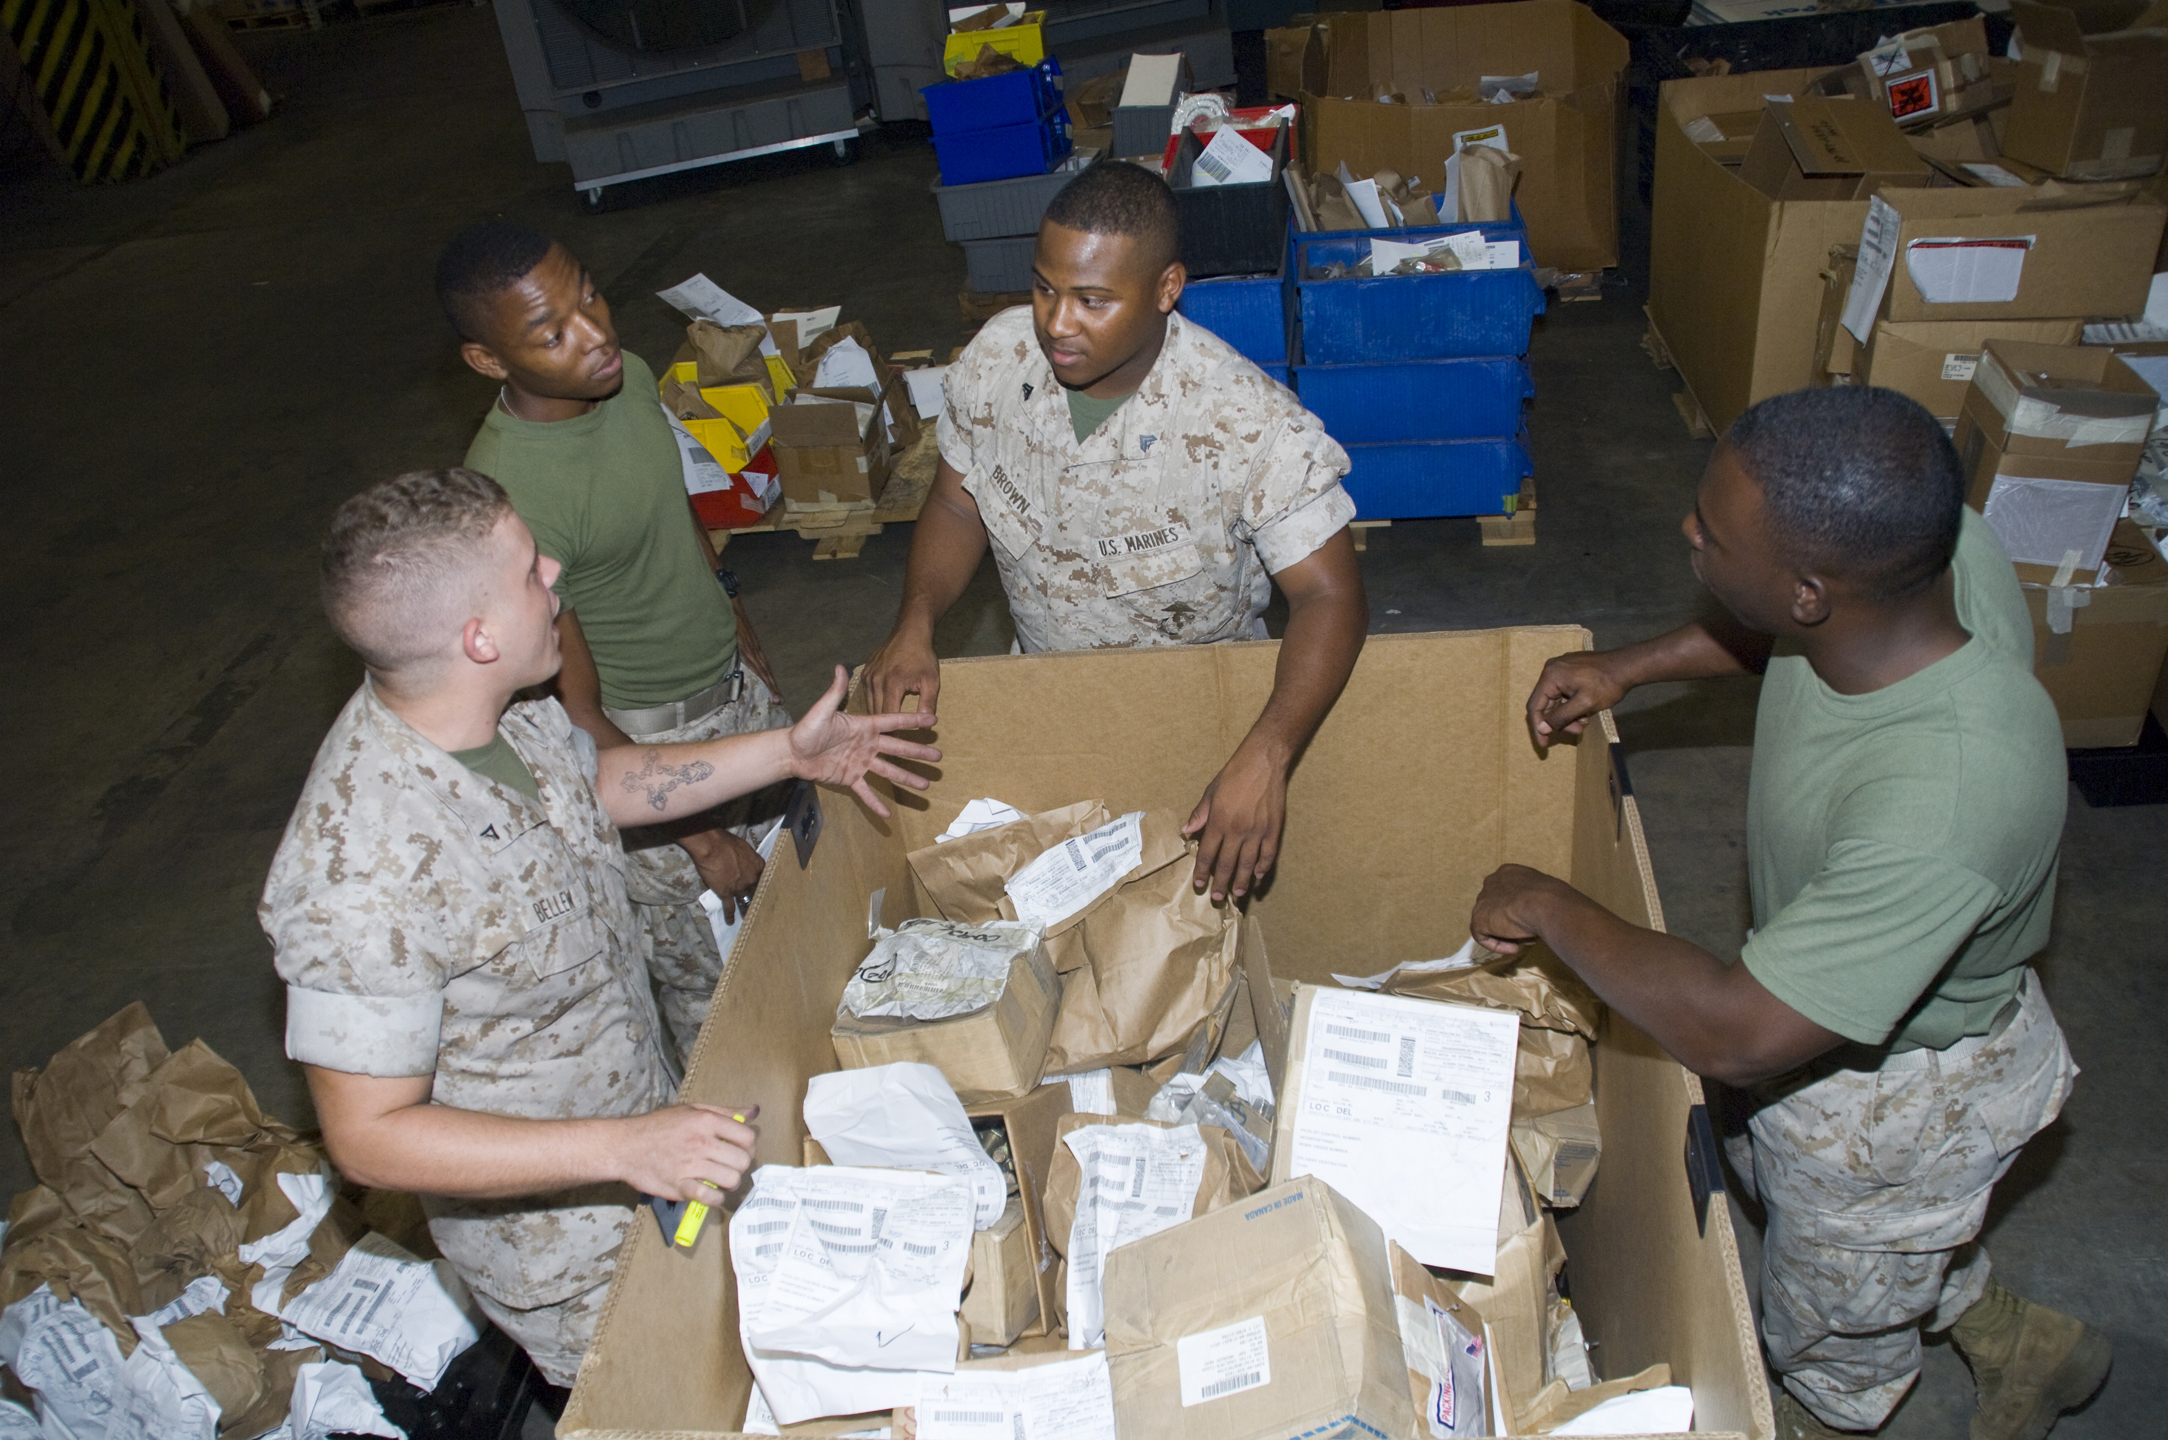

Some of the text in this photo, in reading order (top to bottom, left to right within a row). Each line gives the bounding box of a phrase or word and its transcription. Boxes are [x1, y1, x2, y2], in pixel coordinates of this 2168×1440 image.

[992, 464, 1031, 515] BROWN
[1098, 526, 1179, 557] U.S. MARINES
[1483, 1090, 1492, 1103] 3
[1309, 1102, 1353, 1117] LOC DEL
[1244, 1191, 1304, 1221] MADE IN CANADA
[942, 1240, 950, 1251] 3
[793, 1248, 814, 1261] LOC
[748, 1274, 769, 1284] LOC
[1441, 1382, 1452, 1422] PACKING
